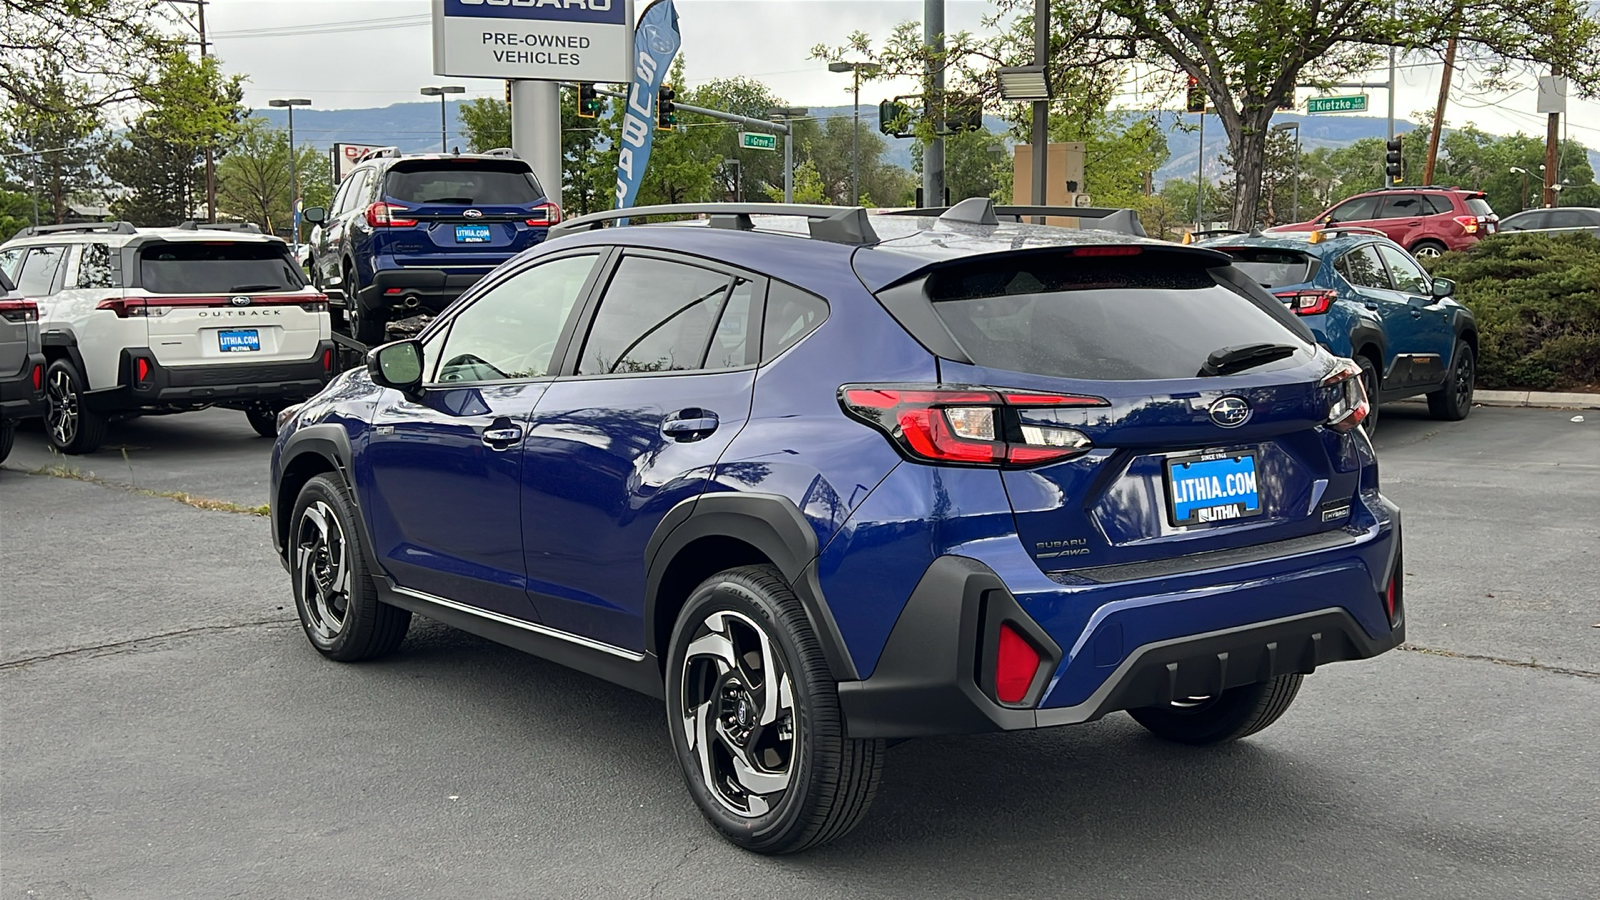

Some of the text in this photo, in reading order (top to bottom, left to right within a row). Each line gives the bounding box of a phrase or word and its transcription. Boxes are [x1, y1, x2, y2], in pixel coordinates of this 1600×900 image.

[482, 32, 591, 49] PRE-OWNED
[493, 50, 581, 66] VEHICLES
[1316, 99, 1351, 111] Kietzke
[606, 51, 658, 227] SUBAR
[753, 137, 768, 147] Grove
[456, 229, 490, 238] LITHIA.COM
[199, 309, 281, 317] OUTBACK
[220, 336, 258, 346] LITHIA.COM
[1201, 453, 1215, 461] SINCE
[1172, 470, 1258, 504] LITHIA.COM
[1208, 503, 1241, 521] LITHIA
[1036, 538, 1087, 549] SUBARU
[1057, 548, 1091, 558] AWD
